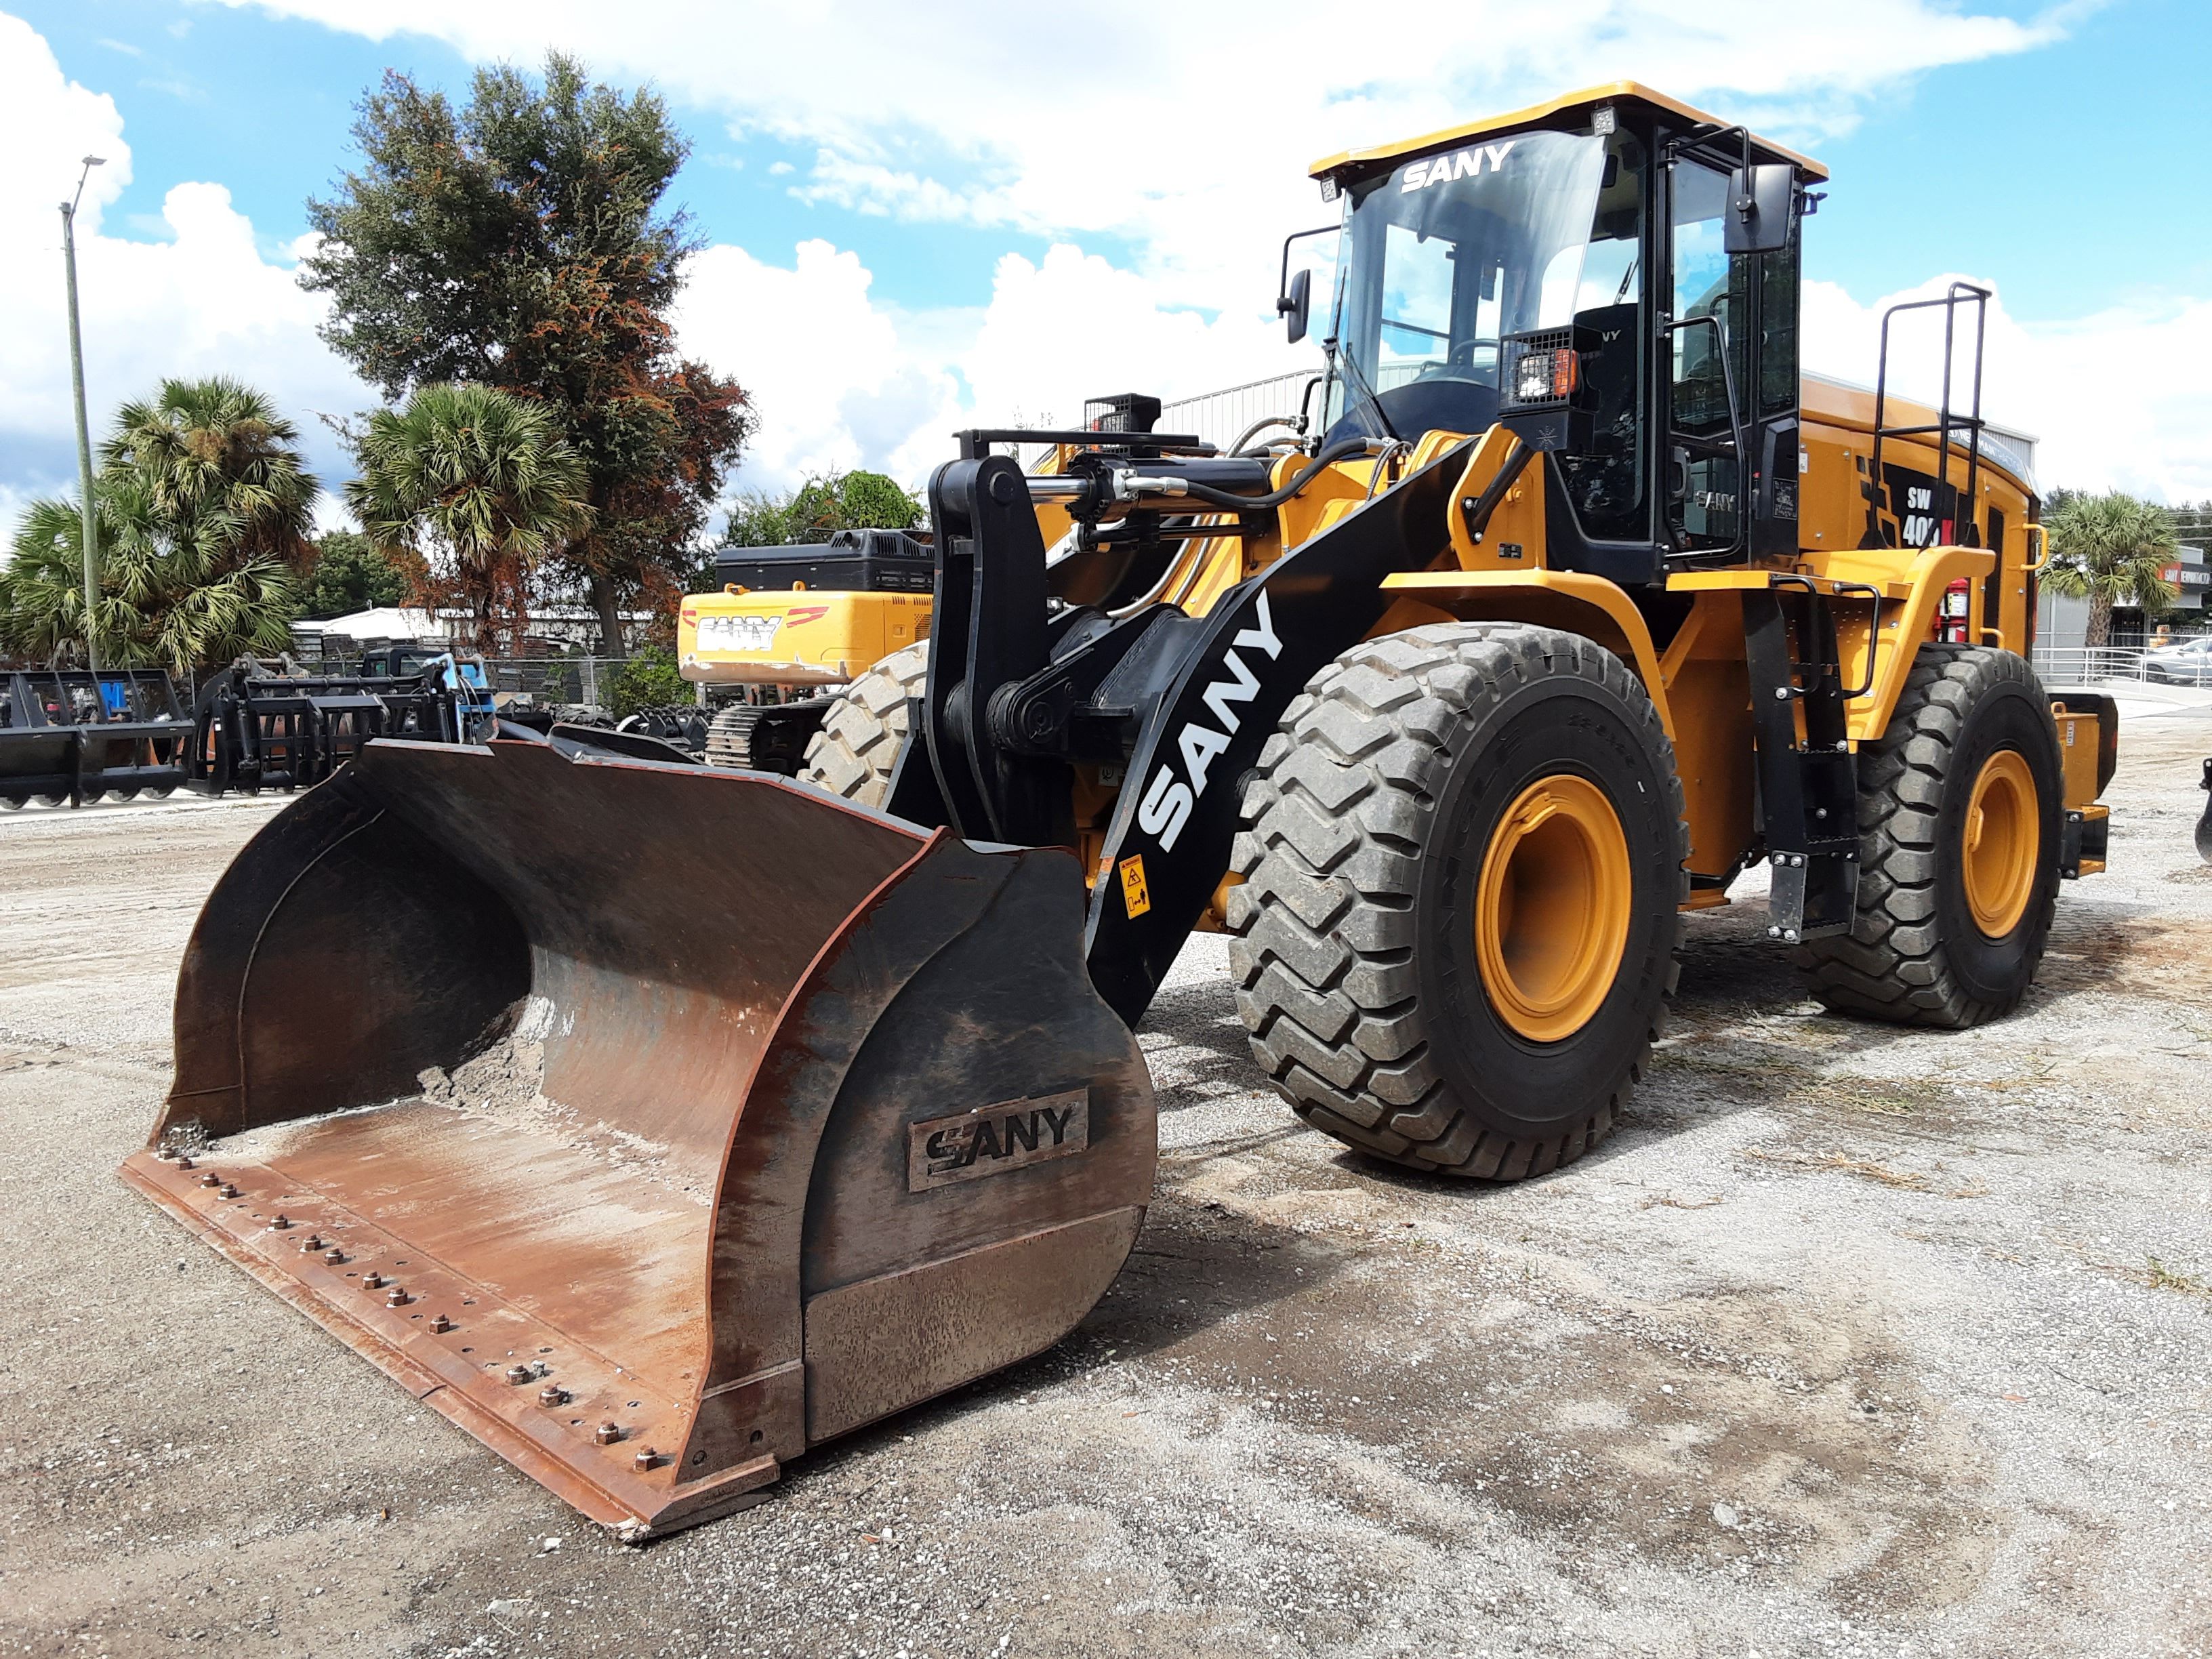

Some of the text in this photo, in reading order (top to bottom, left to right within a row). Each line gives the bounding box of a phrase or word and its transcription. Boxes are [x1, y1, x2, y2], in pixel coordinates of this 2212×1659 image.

[1401, 140, 1516, 194] SANY
[1696, 490, 1736, 512] SANY
[1907, 487, 1931, 510] SW
[697, 616, 783, 651] SANY
[1138, 586, 1284, 853] SANY
[926, 1101, 1079, 1176] SANY
